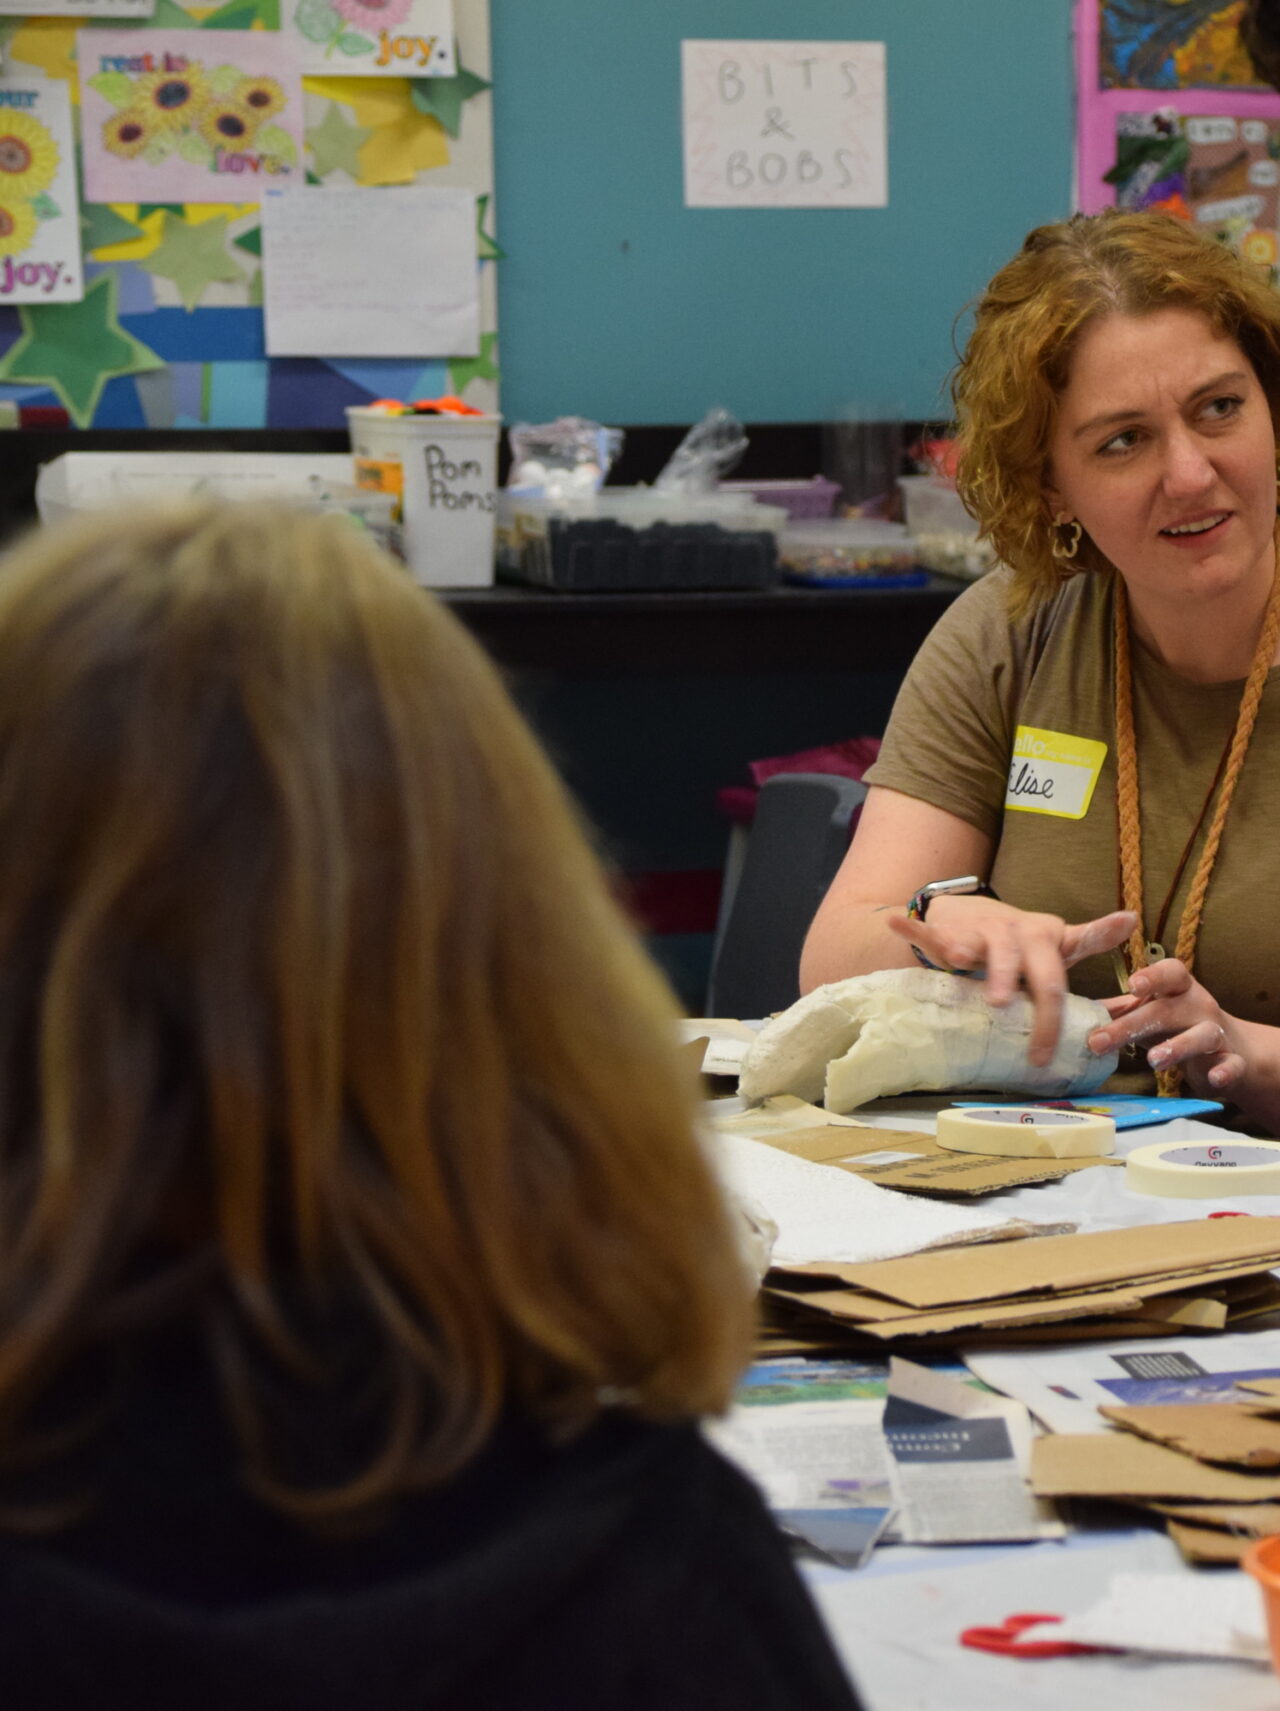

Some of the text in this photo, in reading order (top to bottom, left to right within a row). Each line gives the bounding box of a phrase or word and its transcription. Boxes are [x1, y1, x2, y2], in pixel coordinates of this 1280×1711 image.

[375, 29, 446, 67] joy.
[717, 57, 858, 105] BITS
[759, 105, 796, 141] &
[725, 148, 854, 190] BOBS
[424, 444, 482, 481] Pom
[428, 480, 497, 513] Poms
